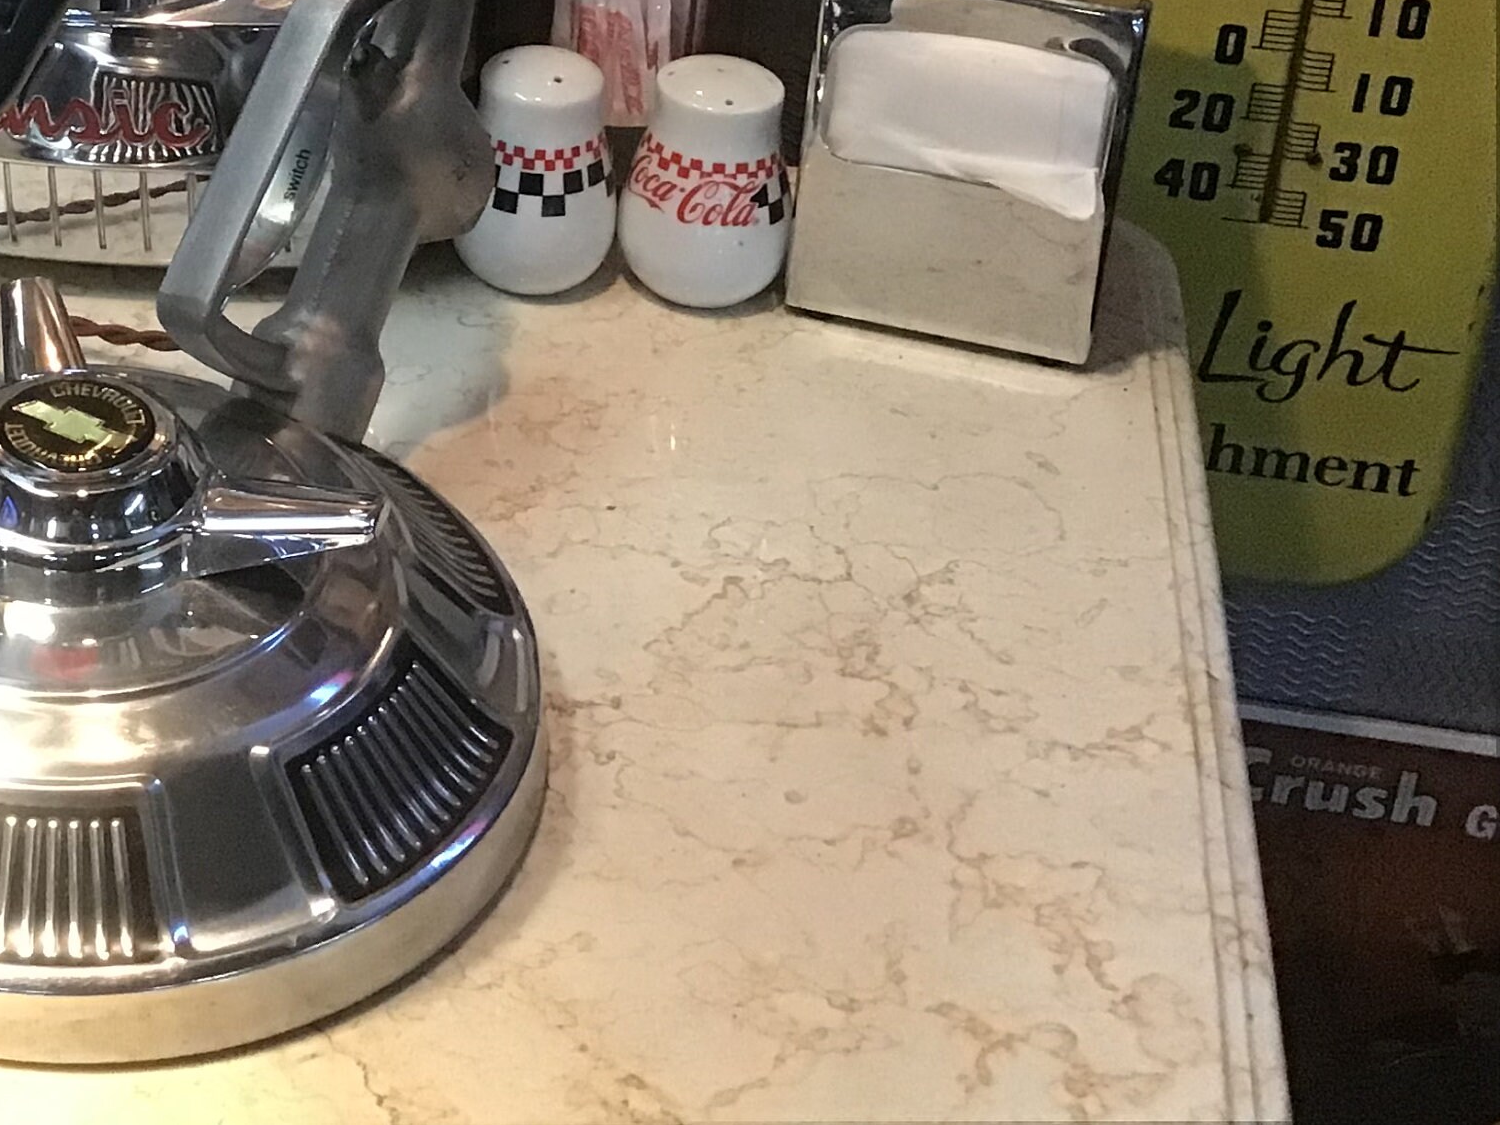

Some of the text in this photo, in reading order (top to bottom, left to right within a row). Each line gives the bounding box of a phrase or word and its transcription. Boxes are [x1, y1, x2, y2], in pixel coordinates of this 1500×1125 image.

[1214, 23, 1248, 66] 0
[1168, 88, 1235, 134] 20
[1351, 73, 1415, 117] 10
[284, 147, 313, 200] switch
[1153, 157, 1221, 202] 40
[1328, 141, 1400, 187] 30
[628, 154, 760, 227] Coca-Cola
[1315, 208, 1384, 253] 50
[1199, 289, 1461, 404] Light
[1204, 422, 1422, 497] hment
[1291, 753, 1384, 781] ORANGE
